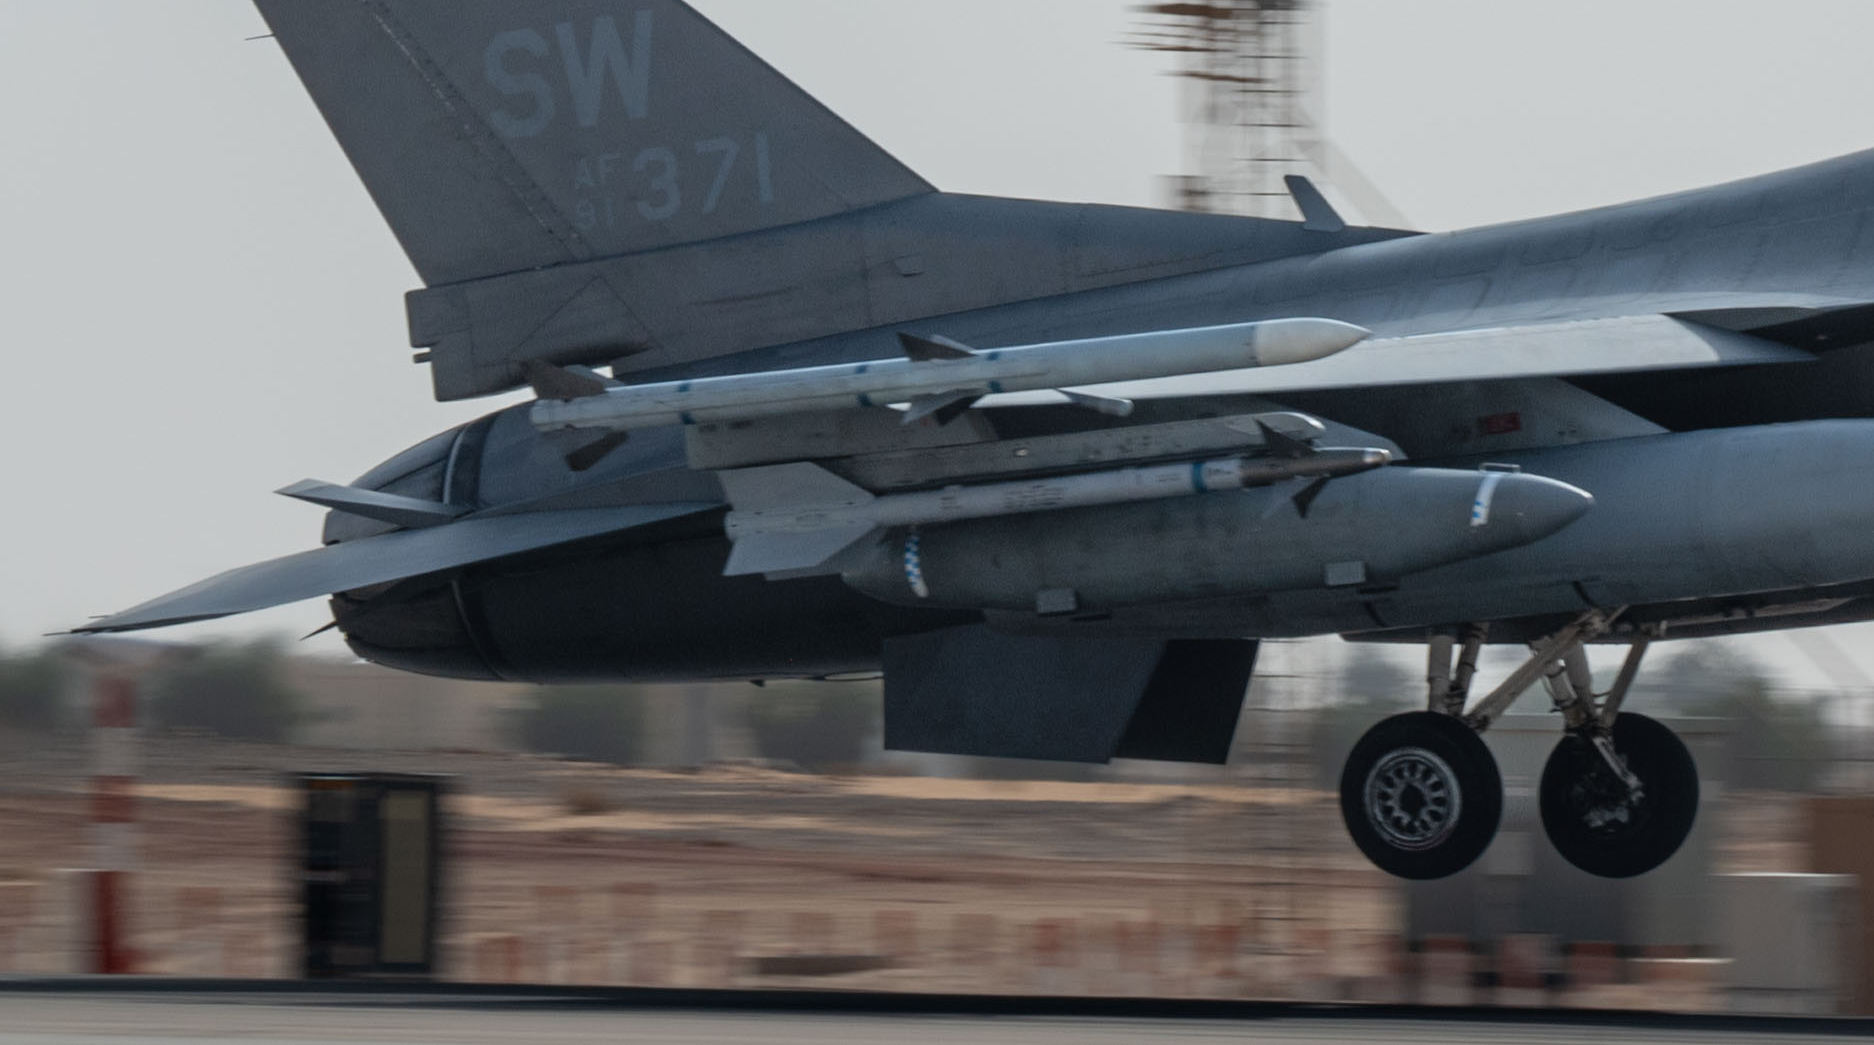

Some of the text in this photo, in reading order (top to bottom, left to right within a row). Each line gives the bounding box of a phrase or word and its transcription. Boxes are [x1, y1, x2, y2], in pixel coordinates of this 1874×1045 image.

[483, 9, 654, 139] SW
[574, 152, 623, 190] AF
[632, 131, 776, 222] 371
